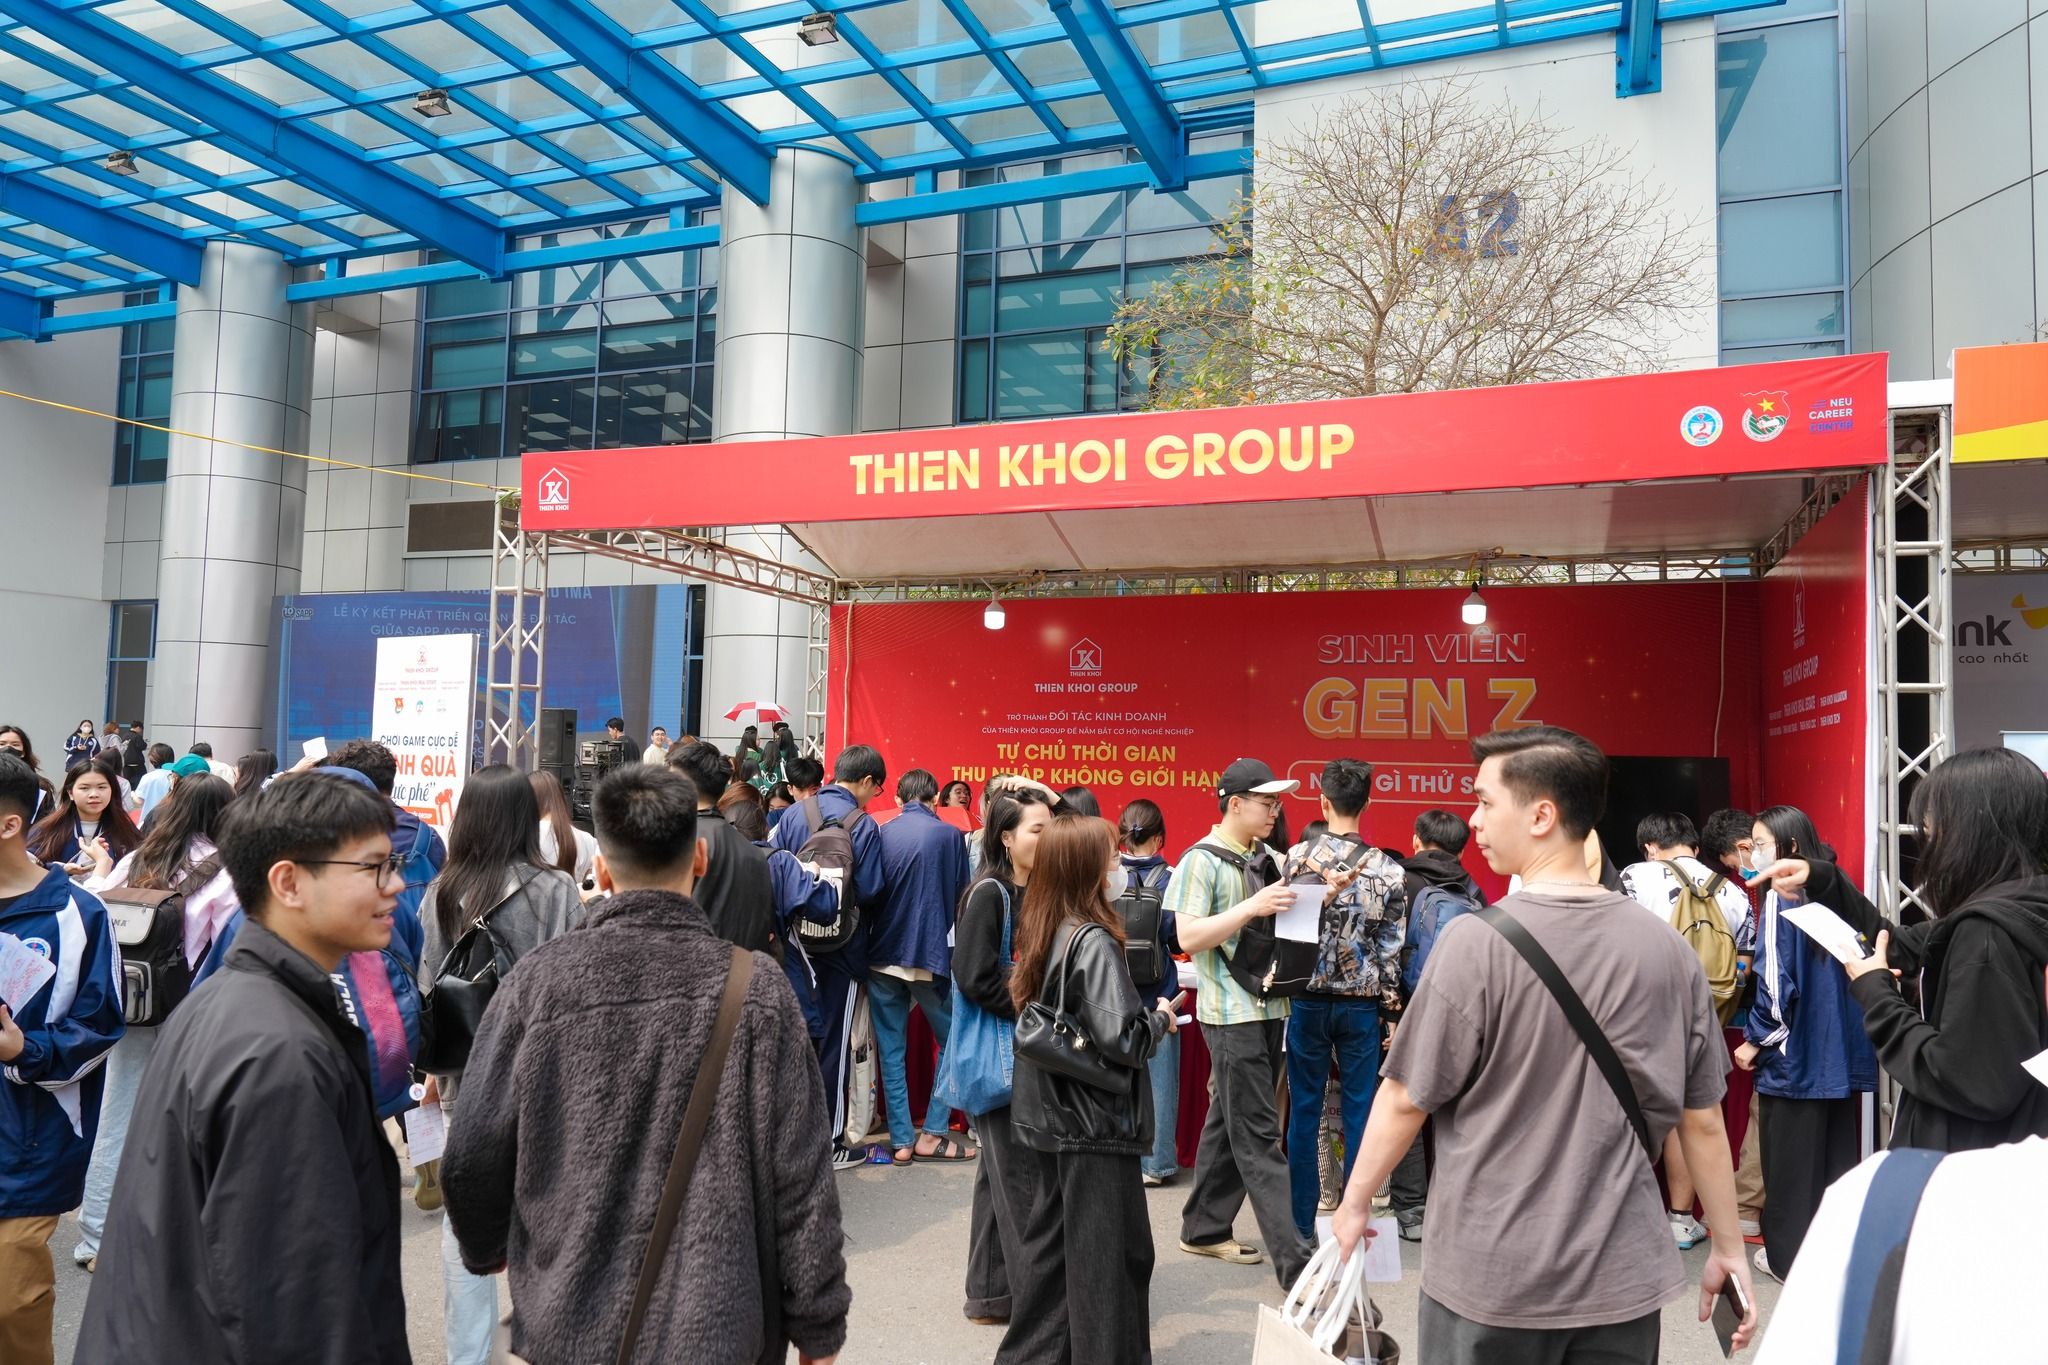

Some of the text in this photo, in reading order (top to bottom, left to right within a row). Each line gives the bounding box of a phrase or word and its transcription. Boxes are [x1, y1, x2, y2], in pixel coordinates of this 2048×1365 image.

[1830, 397, 1853, 407] NEU
[1809, 408, 1853, 420] CAREER
[849, 423, 1355, 495] THIEN KHOI GROUP
[474, 611, 508, 622] QUN
[1317, 626, 1527, 664] SINH VIÊN
[1959, 652, 2029, 664] cao nhất
[1034, 683, 1138, 693] THIEN KHOI GROUP
[1048, 710, 1069, 721] ĐỐI
[1072, 711, 1092, 721] TÁC
[1095, 713, 1122, 721] KINH
[1125, 713, 1167, 721] DOANH
[1303, 676, 1544, 740] GEN Z
[403, 735, 425, 747] GAME
[997, 739, 1176, 764] TỰ CHỦ THỜI GIAN
[393, 749, 457, 777] NH QUÀ
[951, 766, 986, 782] THU
[1051, 764, 1123, 786] KHÔNG
[1130, 765, 1175, 786] GIỚI
[1375, 771, 1401, 792] GÌ
[1408, 769, 1454, 793] THỬ
[800, 918, 841, 937] ADIDAS
